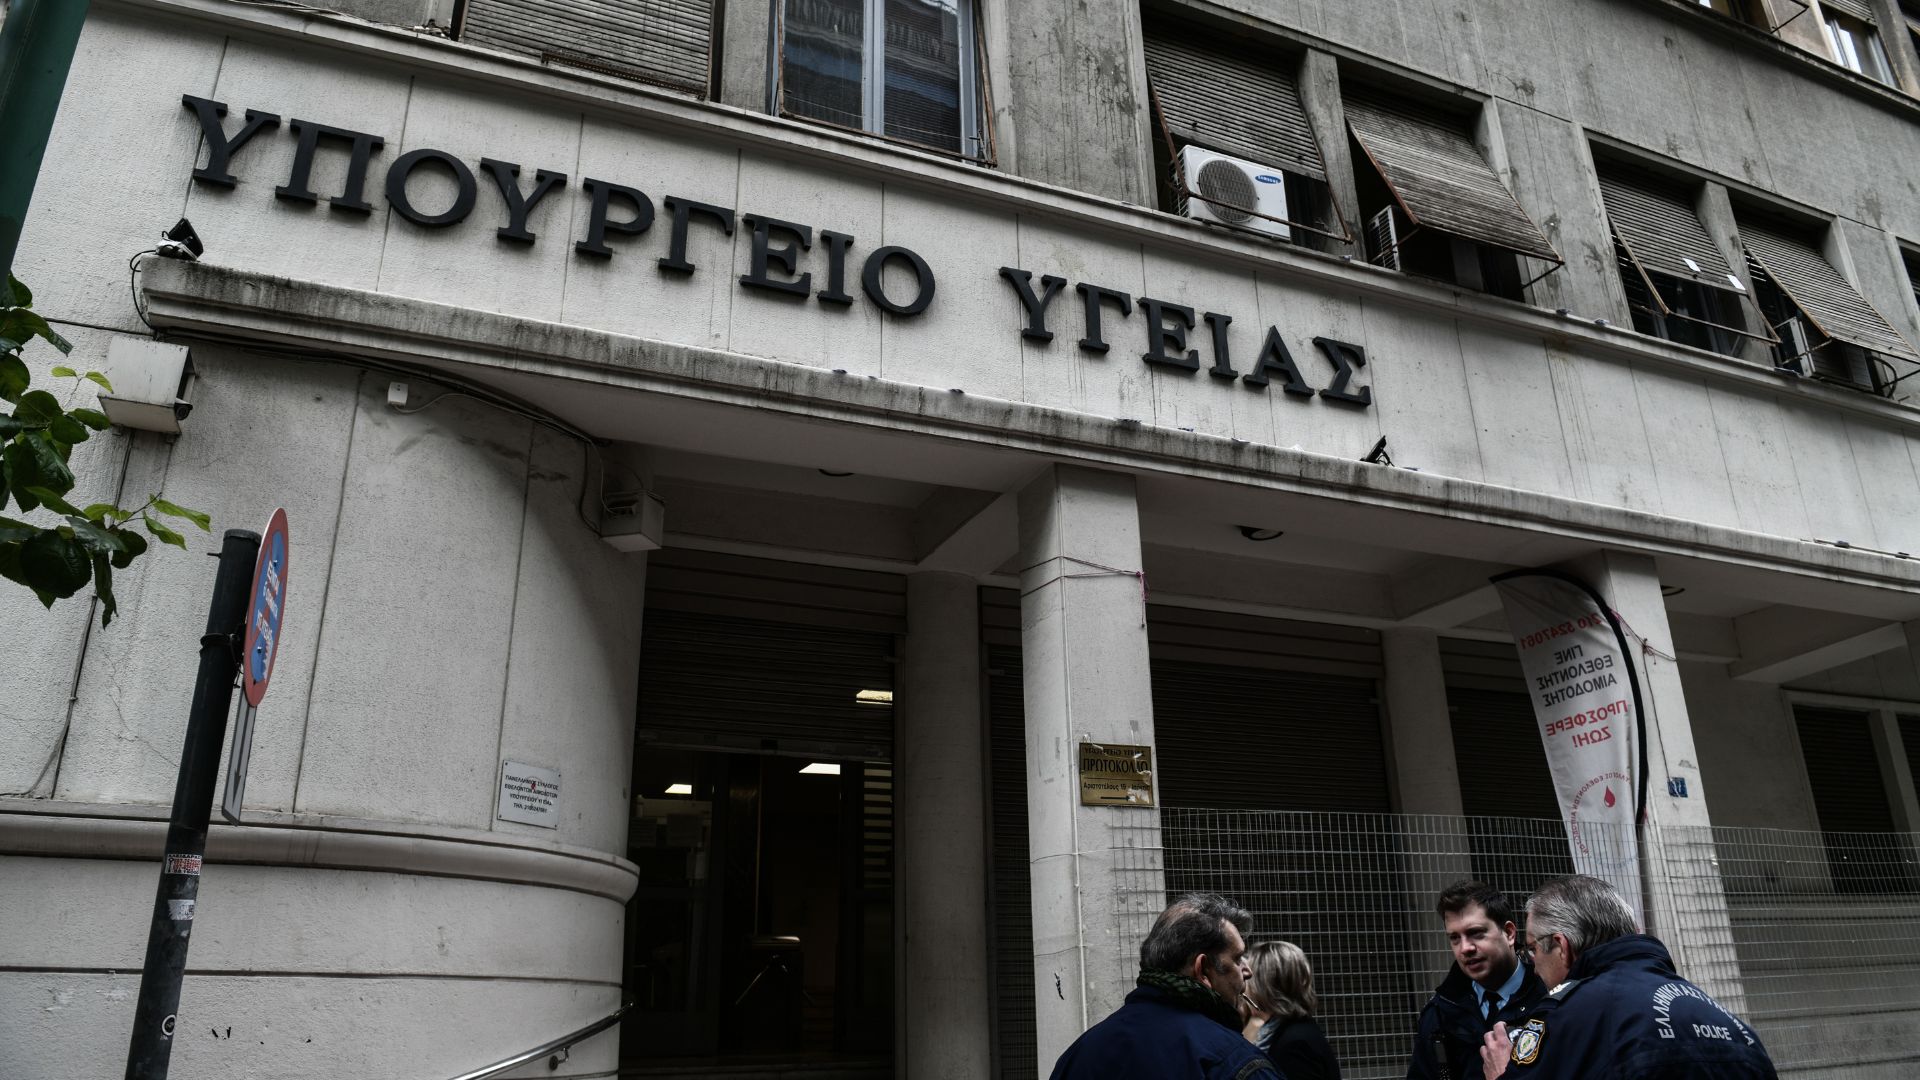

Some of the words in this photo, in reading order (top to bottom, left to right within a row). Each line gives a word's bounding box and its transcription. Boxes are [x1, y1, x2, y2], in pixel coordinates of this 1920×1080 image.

[181, 94, 936, 316] ΥΠΟΥΡΓΕΙΟ
[999, 266, 1372, 407] ΥΓΕΙΑΣ
[1653, 983, 1684, 1039] ΕΛΛΗΝΙΚΗ
[1692, 1023, 1733, 1041] POLICE
